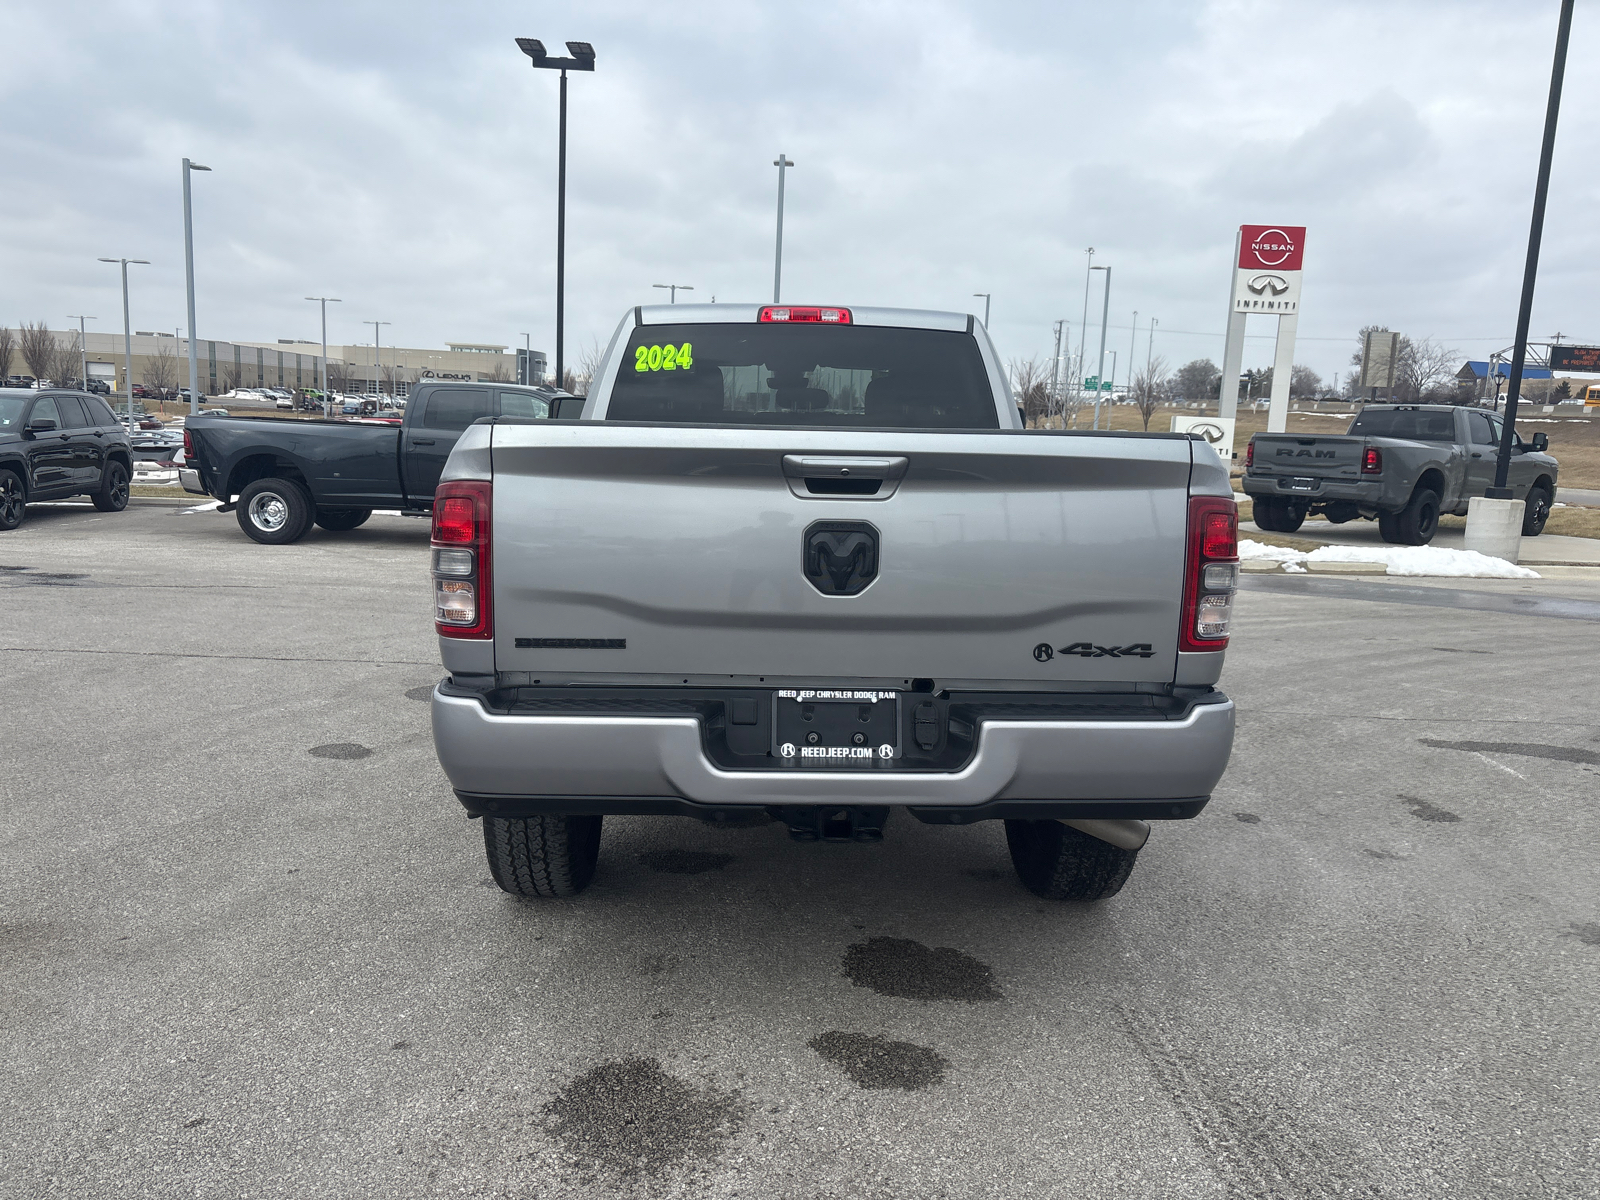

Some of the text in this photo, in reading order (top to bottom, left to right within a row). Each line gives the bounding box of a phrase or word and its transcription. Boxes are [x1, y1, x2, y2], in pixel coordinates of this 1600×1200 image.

[1252, 243, 1294, 251] NISSAN
[1237, 300, 1296, 309] INFINITI
[635, 342, 693, 372] 2024
[1276, 448, 1336, 458] RAM
[778, 689, 797, 698] REED
[799, 690, 815, 698] JEEP
[816, 690, 853, 699] CHRYSLER
[854, 691, 877, 699] DODGE
[801, 747, 873, 758] REEDJEEP.COM
